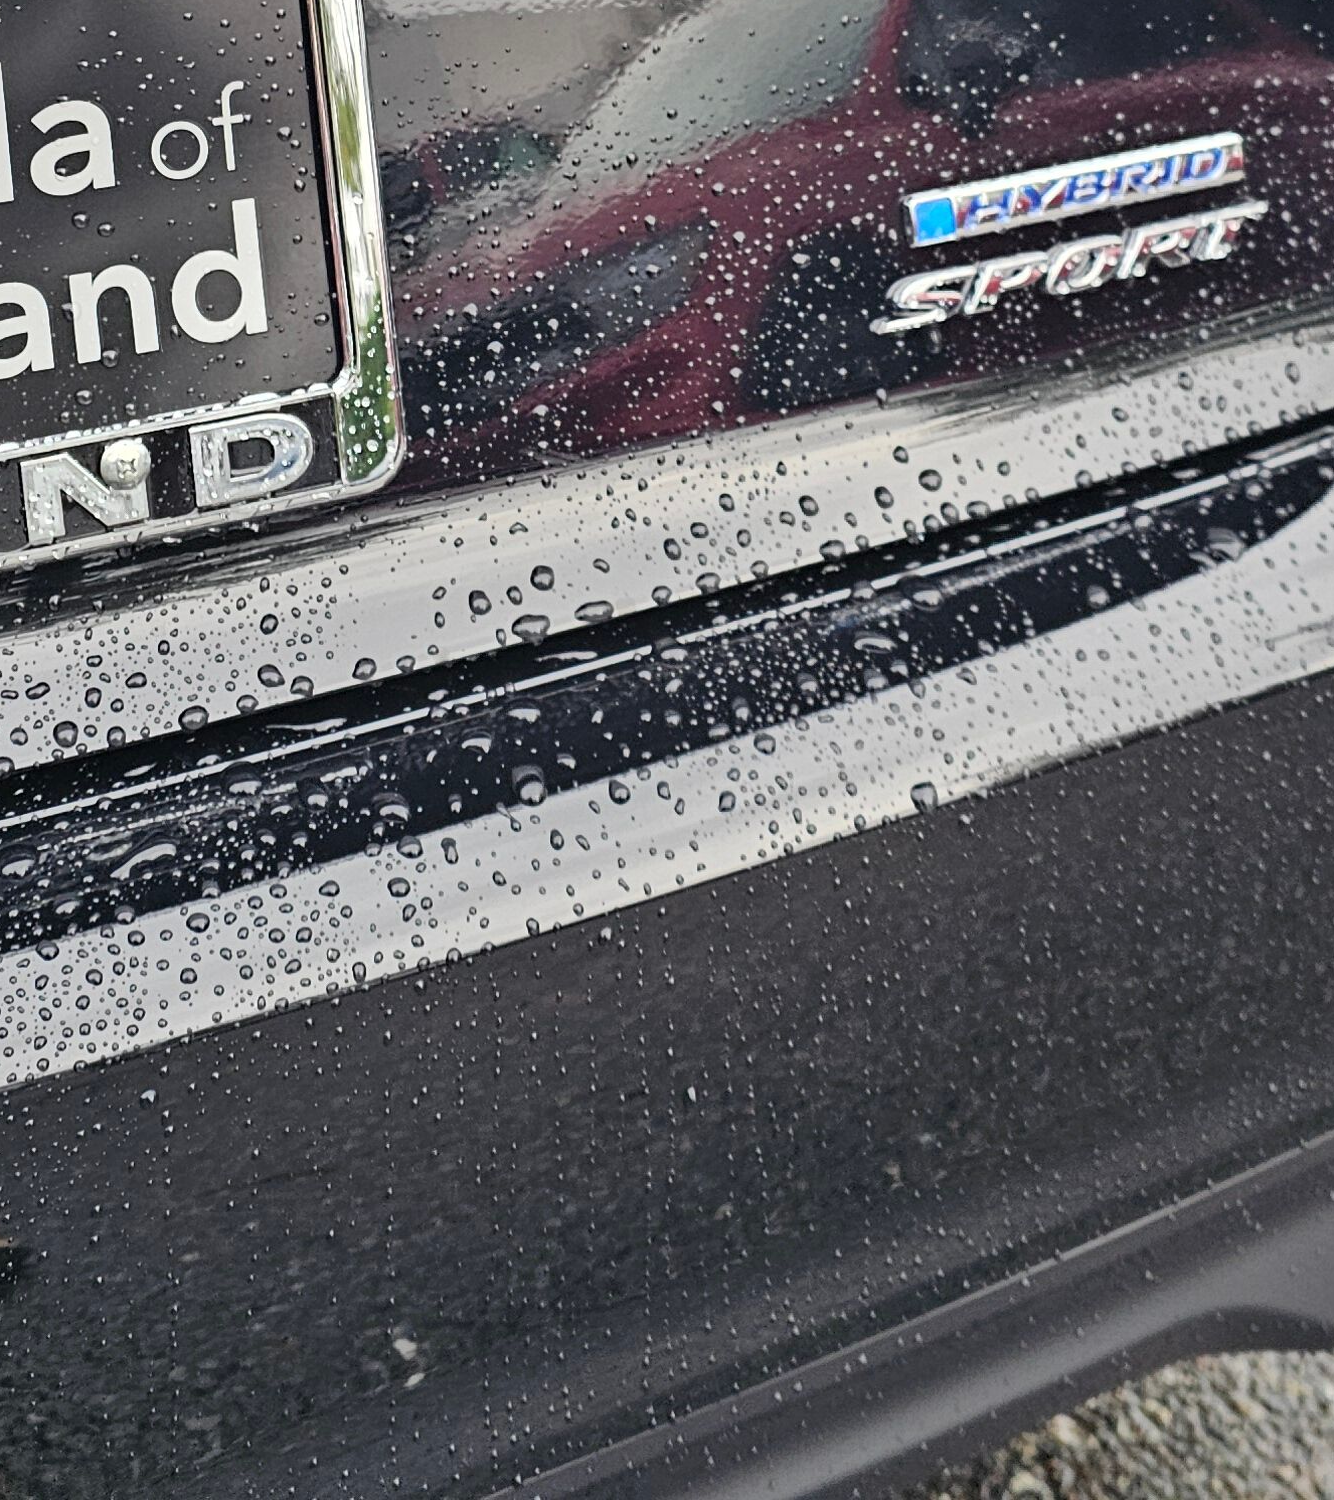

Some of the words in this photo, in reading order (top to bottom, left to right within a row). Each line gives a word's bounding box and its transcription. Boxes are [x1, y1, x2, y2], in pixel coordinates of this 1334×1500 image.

[150, 79, 244, 181] of
[957, 148, 1229, 230] HYBRID
[870, 199, 1269, 335] SPORT
